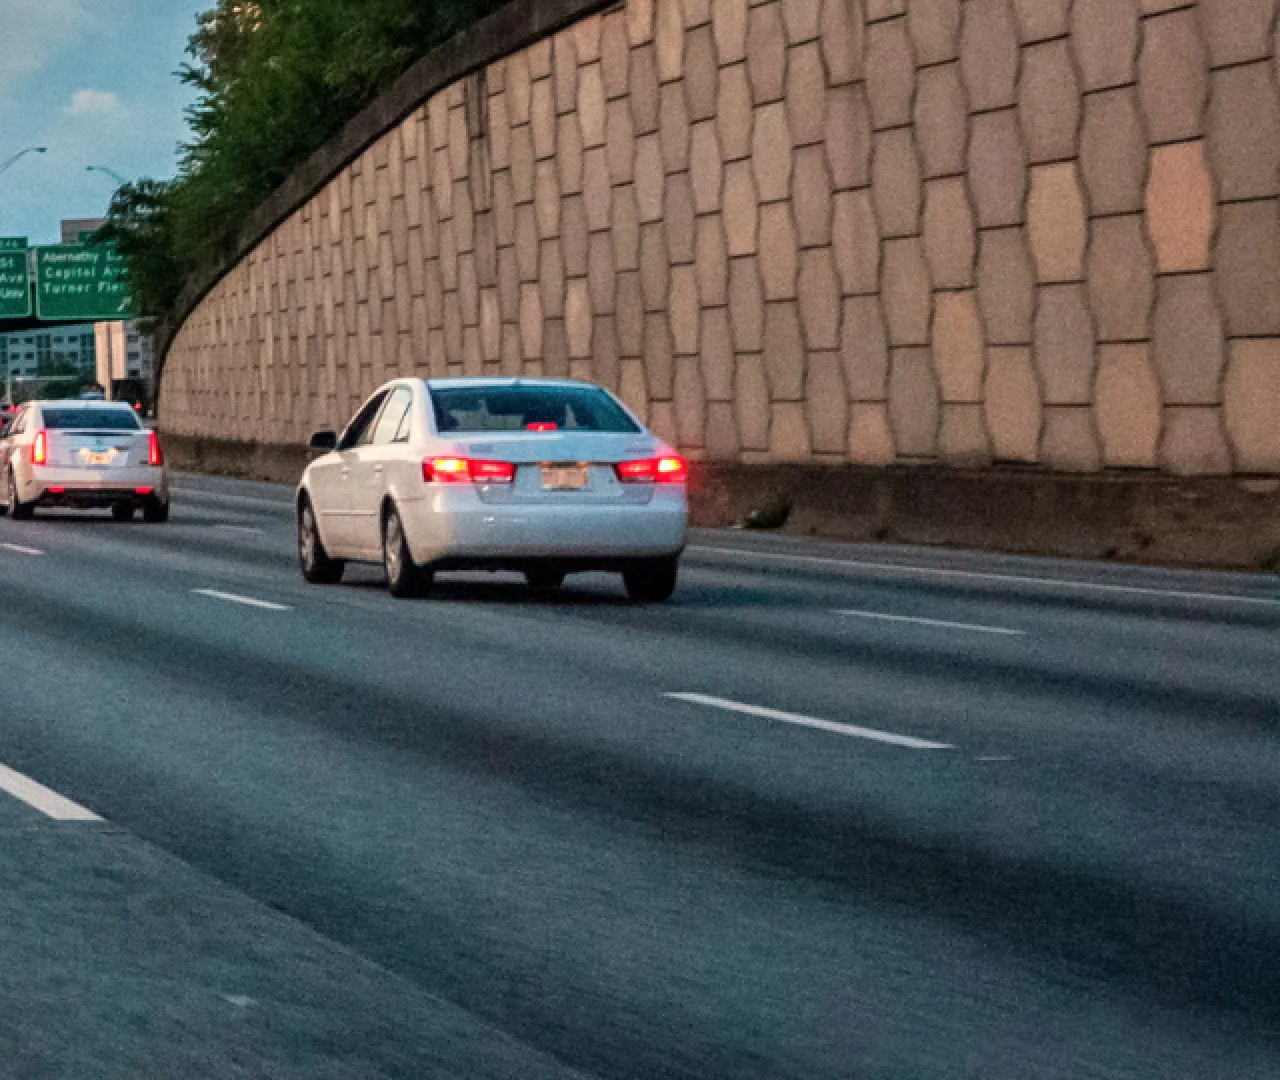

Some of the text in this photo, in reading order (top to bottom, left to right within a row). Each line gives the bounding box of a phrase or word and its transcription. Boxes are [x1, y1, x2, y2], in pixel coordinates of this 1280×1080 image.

[0, 256, 15, 269] St
[0, 272, 23, 285] Ave
[45, 265, 96, 280] Capitol
[0, 287, 24, 299] Univ
[43, 281, 91, 294] Turner
